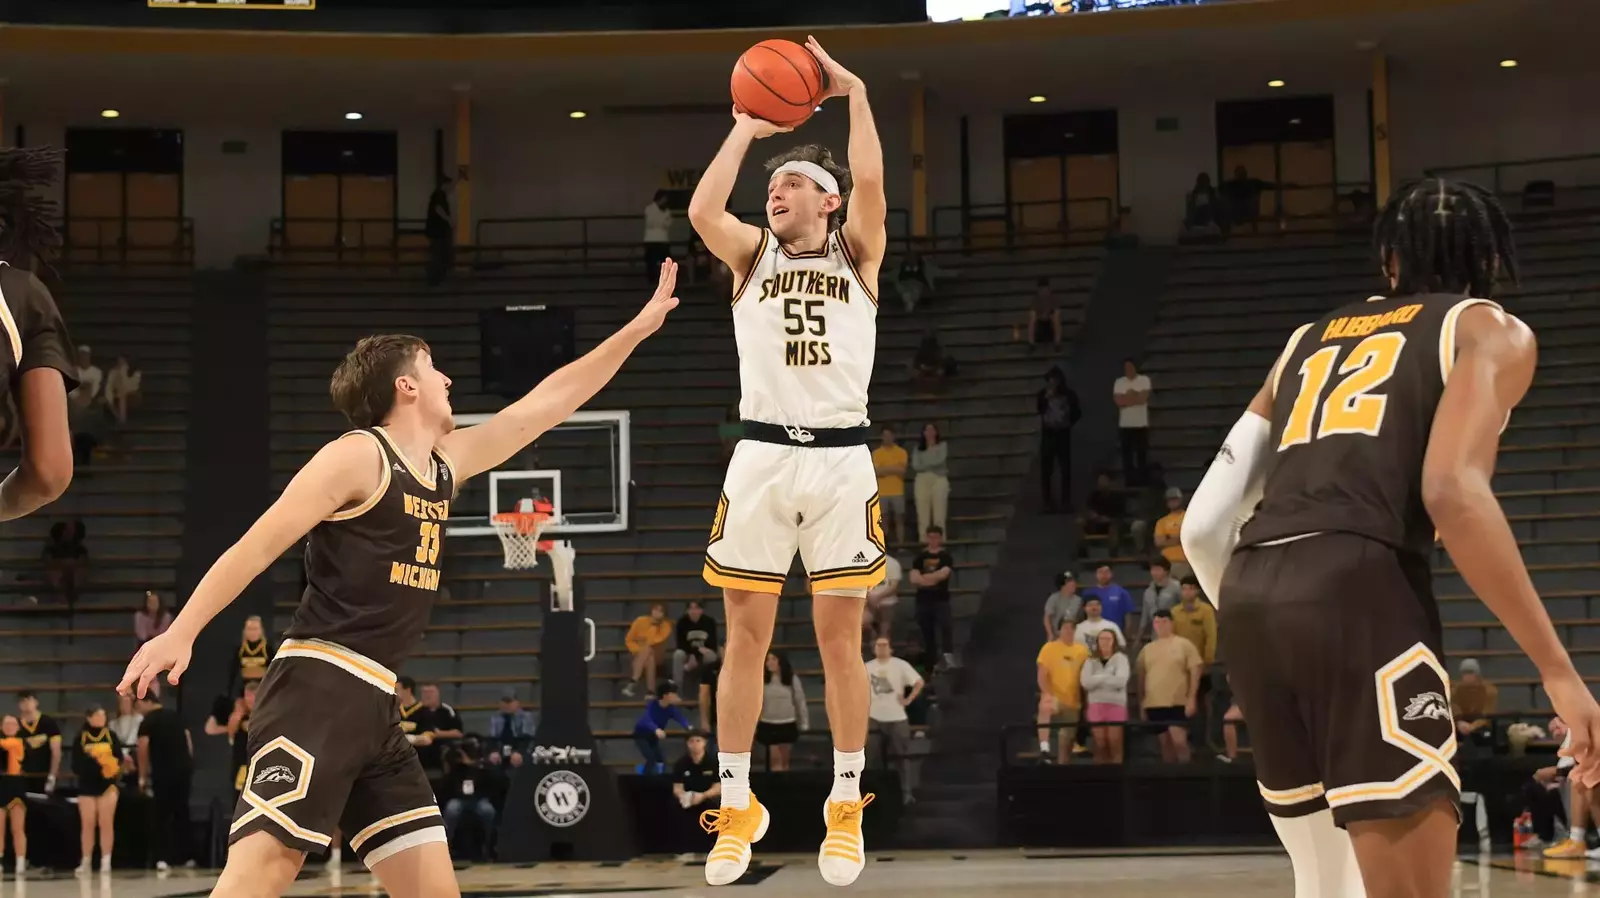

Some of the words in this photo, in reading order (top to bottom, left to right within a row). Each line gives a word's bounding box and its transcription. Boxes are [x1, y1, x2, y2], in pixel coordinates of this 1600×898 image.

[667, 168, 706, 187] WE
[758, 270, 850, 304] SOUTHERN
[783, 297, 827, 337] 55
[1320, 303, 1424, 342] HUBBARD
[785, 340, 832, 366] MISS
[1276, 331, 1408, 453] 12
[403, 492, 450, 521] WESTEN
[415, 521, 440, 565] 33
